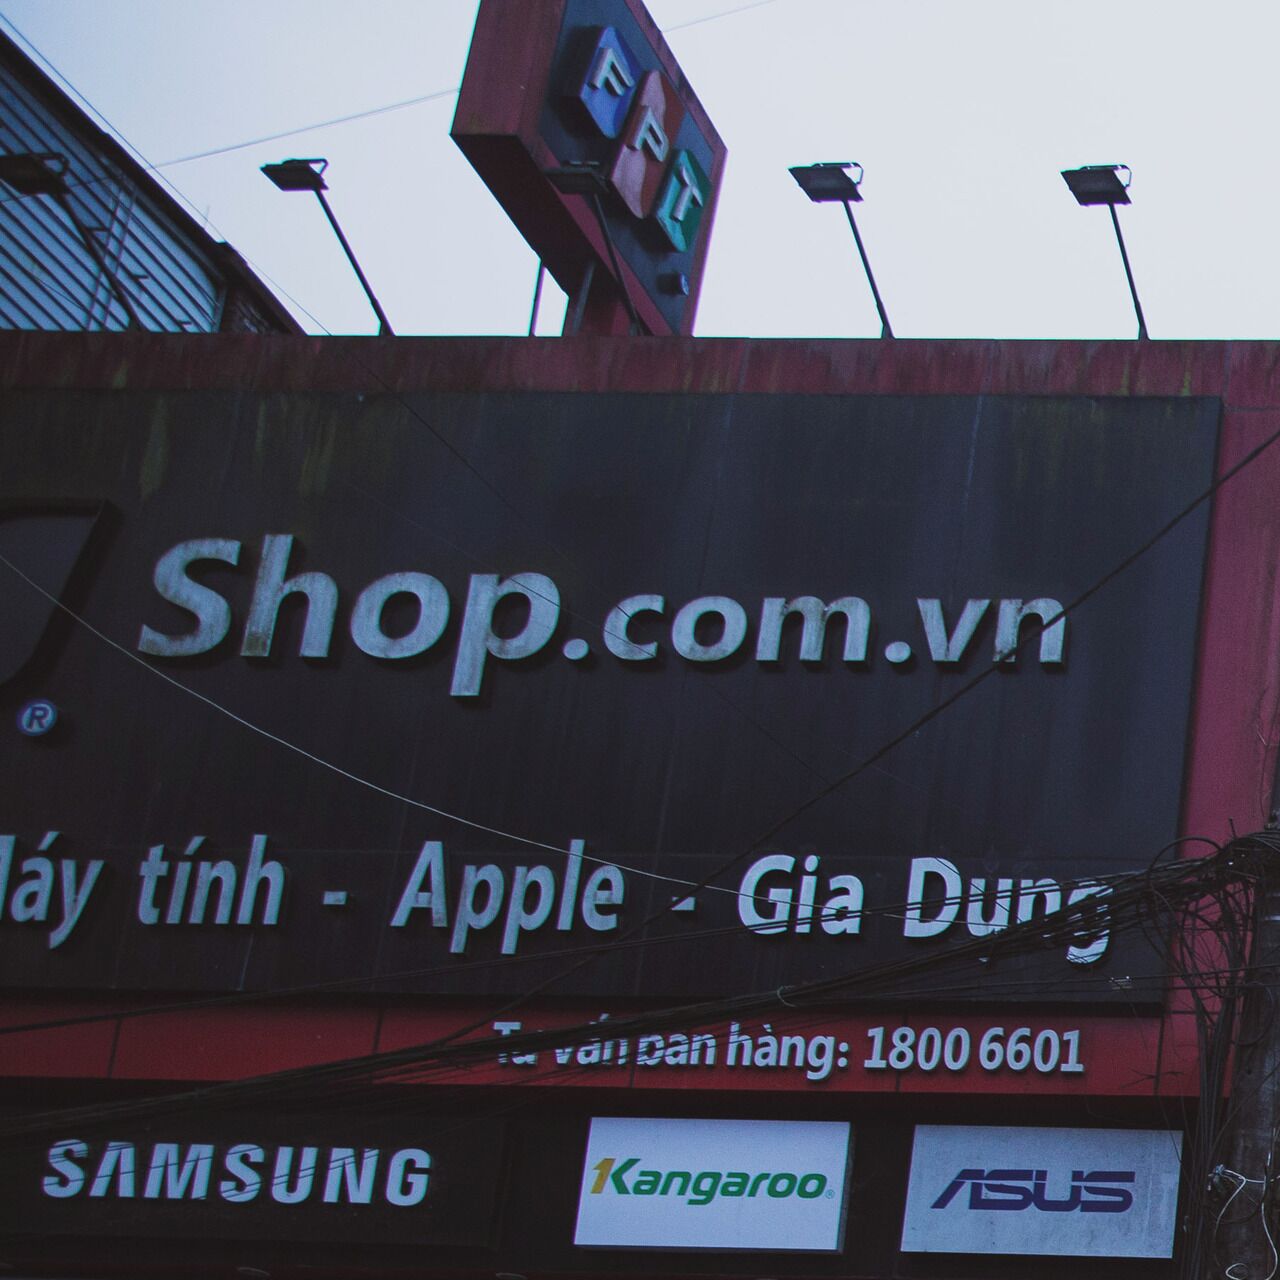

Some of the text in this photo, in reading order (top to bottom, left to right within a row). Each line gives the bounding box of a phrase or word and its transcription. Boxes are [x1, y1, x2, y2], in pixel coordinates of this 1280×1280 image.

[586, 47, 704, 222] FPT
[137, 533, 1069, 697] Shop.com.vn
[137, 834, 285, 925] tính
[390, 839, 624, 955] Apple
[738, 854, 865, 936] Gia
[727, 1021, 1085, 1081] hàng: 1800 6601
[42, 1138, 433, 1207] SAMSUNG
[930, 1169, 1136, 1214] ASUS
